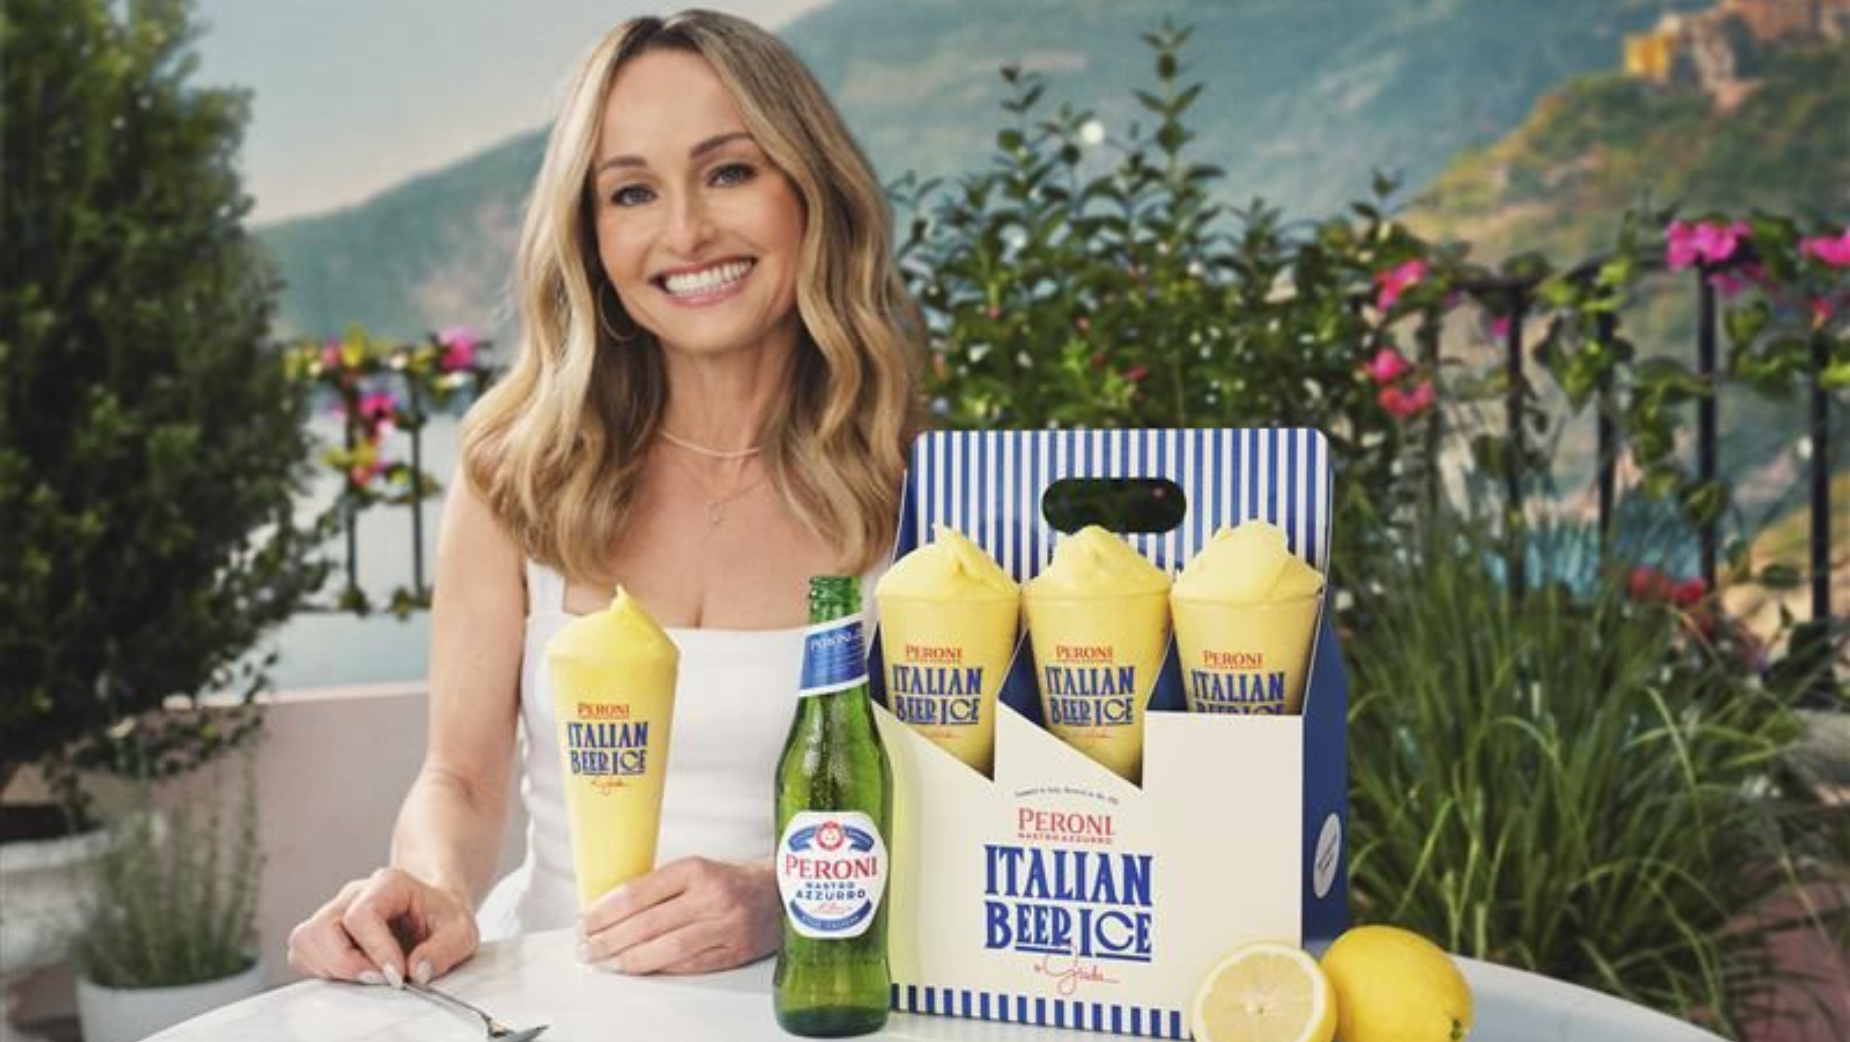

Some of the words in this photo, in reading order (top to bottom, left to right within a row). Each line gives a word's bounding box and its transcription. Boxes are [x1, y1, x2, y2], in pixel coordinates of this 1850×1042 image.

[905, 645, 963, 659] PERONI
[1056, 646, 1113, 659] PERONI
[1203, 650, 1263, 665] PERONI
[892, 665, 983, 695] ITALIAN
[1045, 666, 1135, 696] ITALIAN
[1191, 669, 1285, 702] ITALIAN
[577, 703, 630, 716] PERONI
[895, 694, 937, 723] BEER
[941, 698, 981, 725] ICE
[1050, 696, 1091, 724] BEER
[1095, 697, 1134, 725] ICE
[567, 721, 648, 748] ITALIAN
[570, 750, 611, 775] BEER
[612, 750, 647, 775] ICE
[1018, 807, 1113, 836] PERONI
[784, 853, 878, 880] PERONI
[984, 845, 1153, 907] ITALIAN
[796, 889, 866, 901] AZZURRO
[805, 881, 855, 890] NASTRO
[984, 900, 1072, 951] BEER
[1078, 908, 1153, 960] ICE
